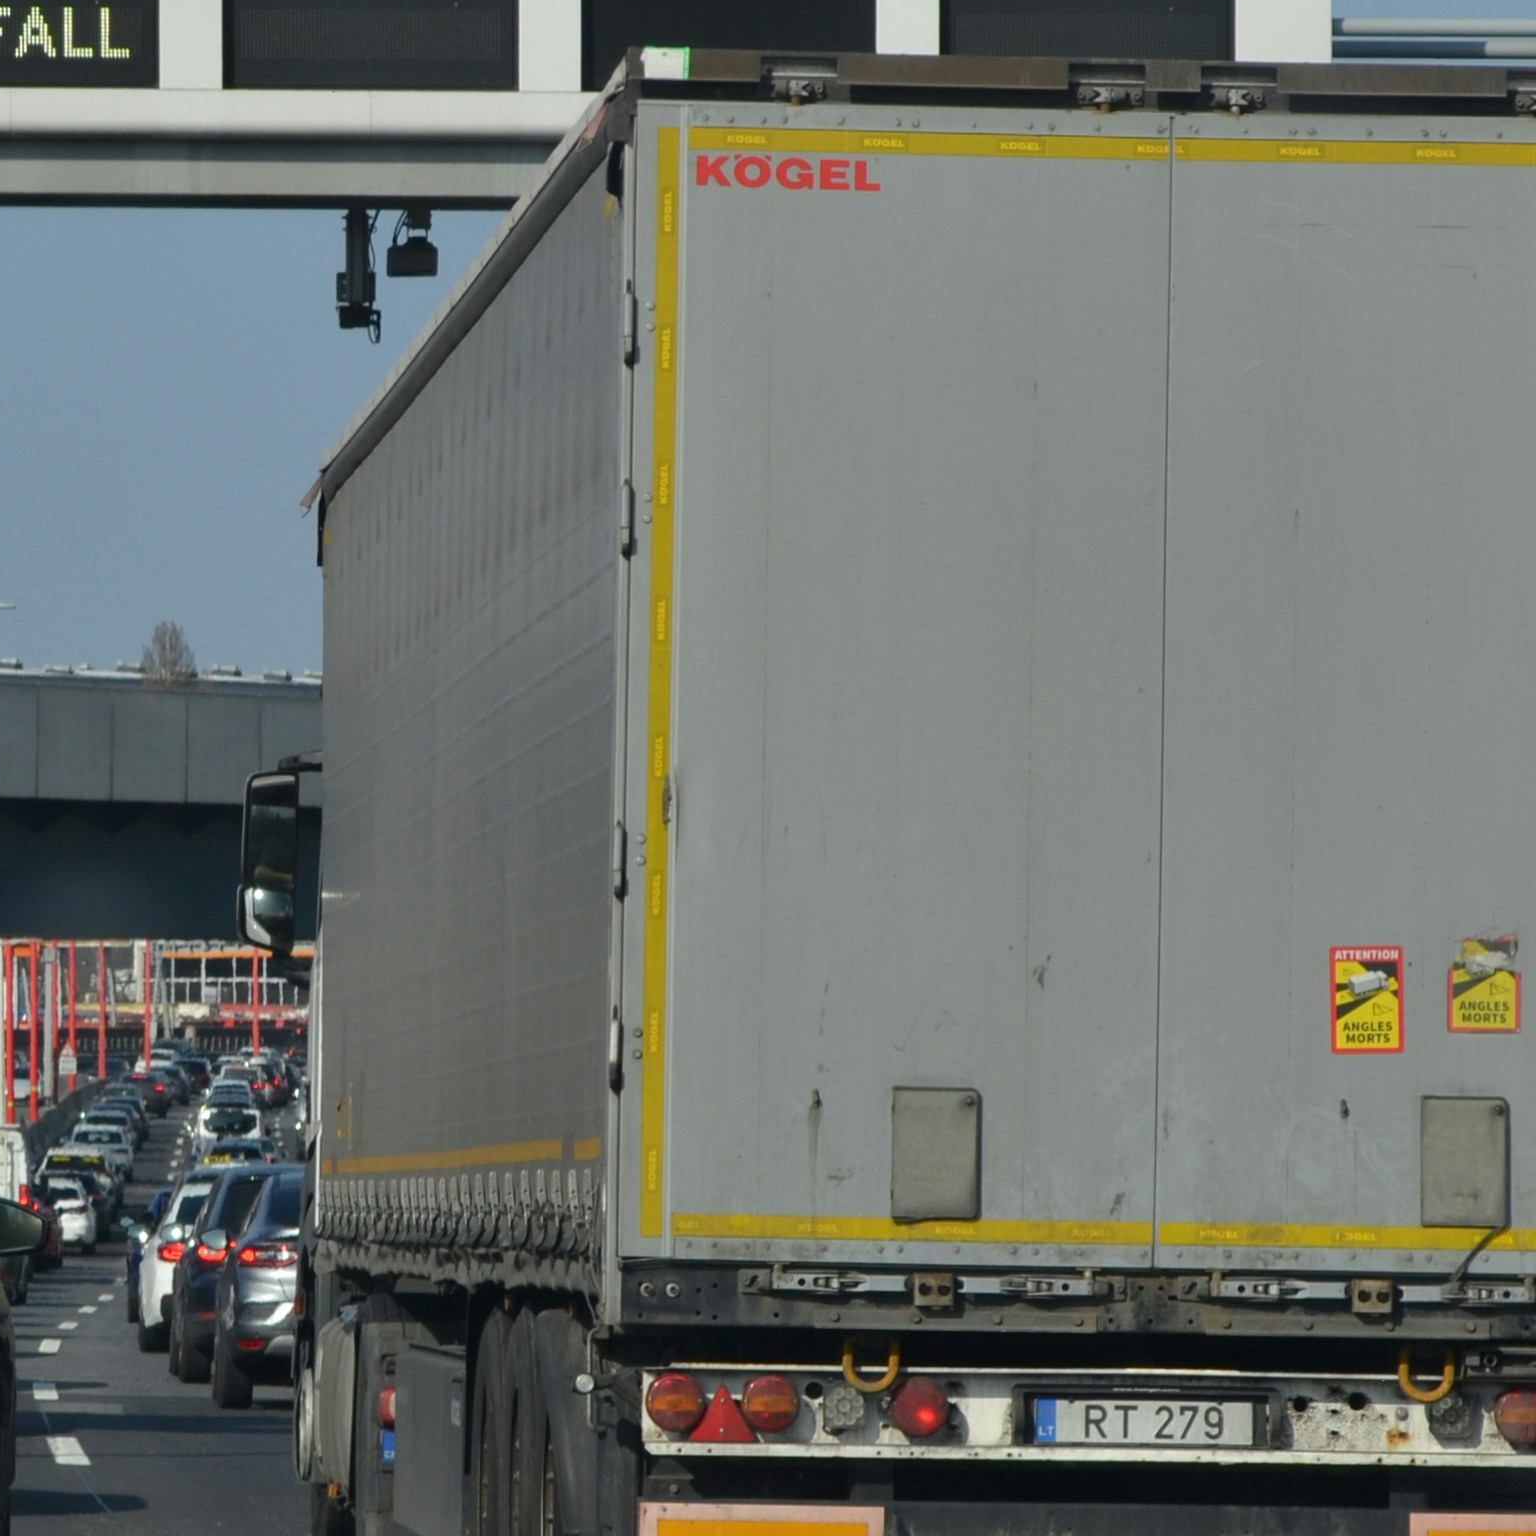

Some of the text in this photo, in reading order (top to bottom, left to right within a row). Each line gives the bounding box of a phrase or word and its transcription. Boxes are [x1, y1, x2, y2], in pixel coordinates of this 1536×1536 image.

[695, 154, 881, 192] KÖGEL
[1334, 949, 1399, 960] ATTENTION
[1458, 1001, 1510, 1012] ANGLES
[1461, 1012, 1507, 1024] MORTS
[1342, 1021, 1393, 1032] ANGLES
[1345, 1033, 1391, 1044] MORTS
[1084, 1404, 1224, 1441] RT 279
[1038, 1425, 1055, 1436] LT
